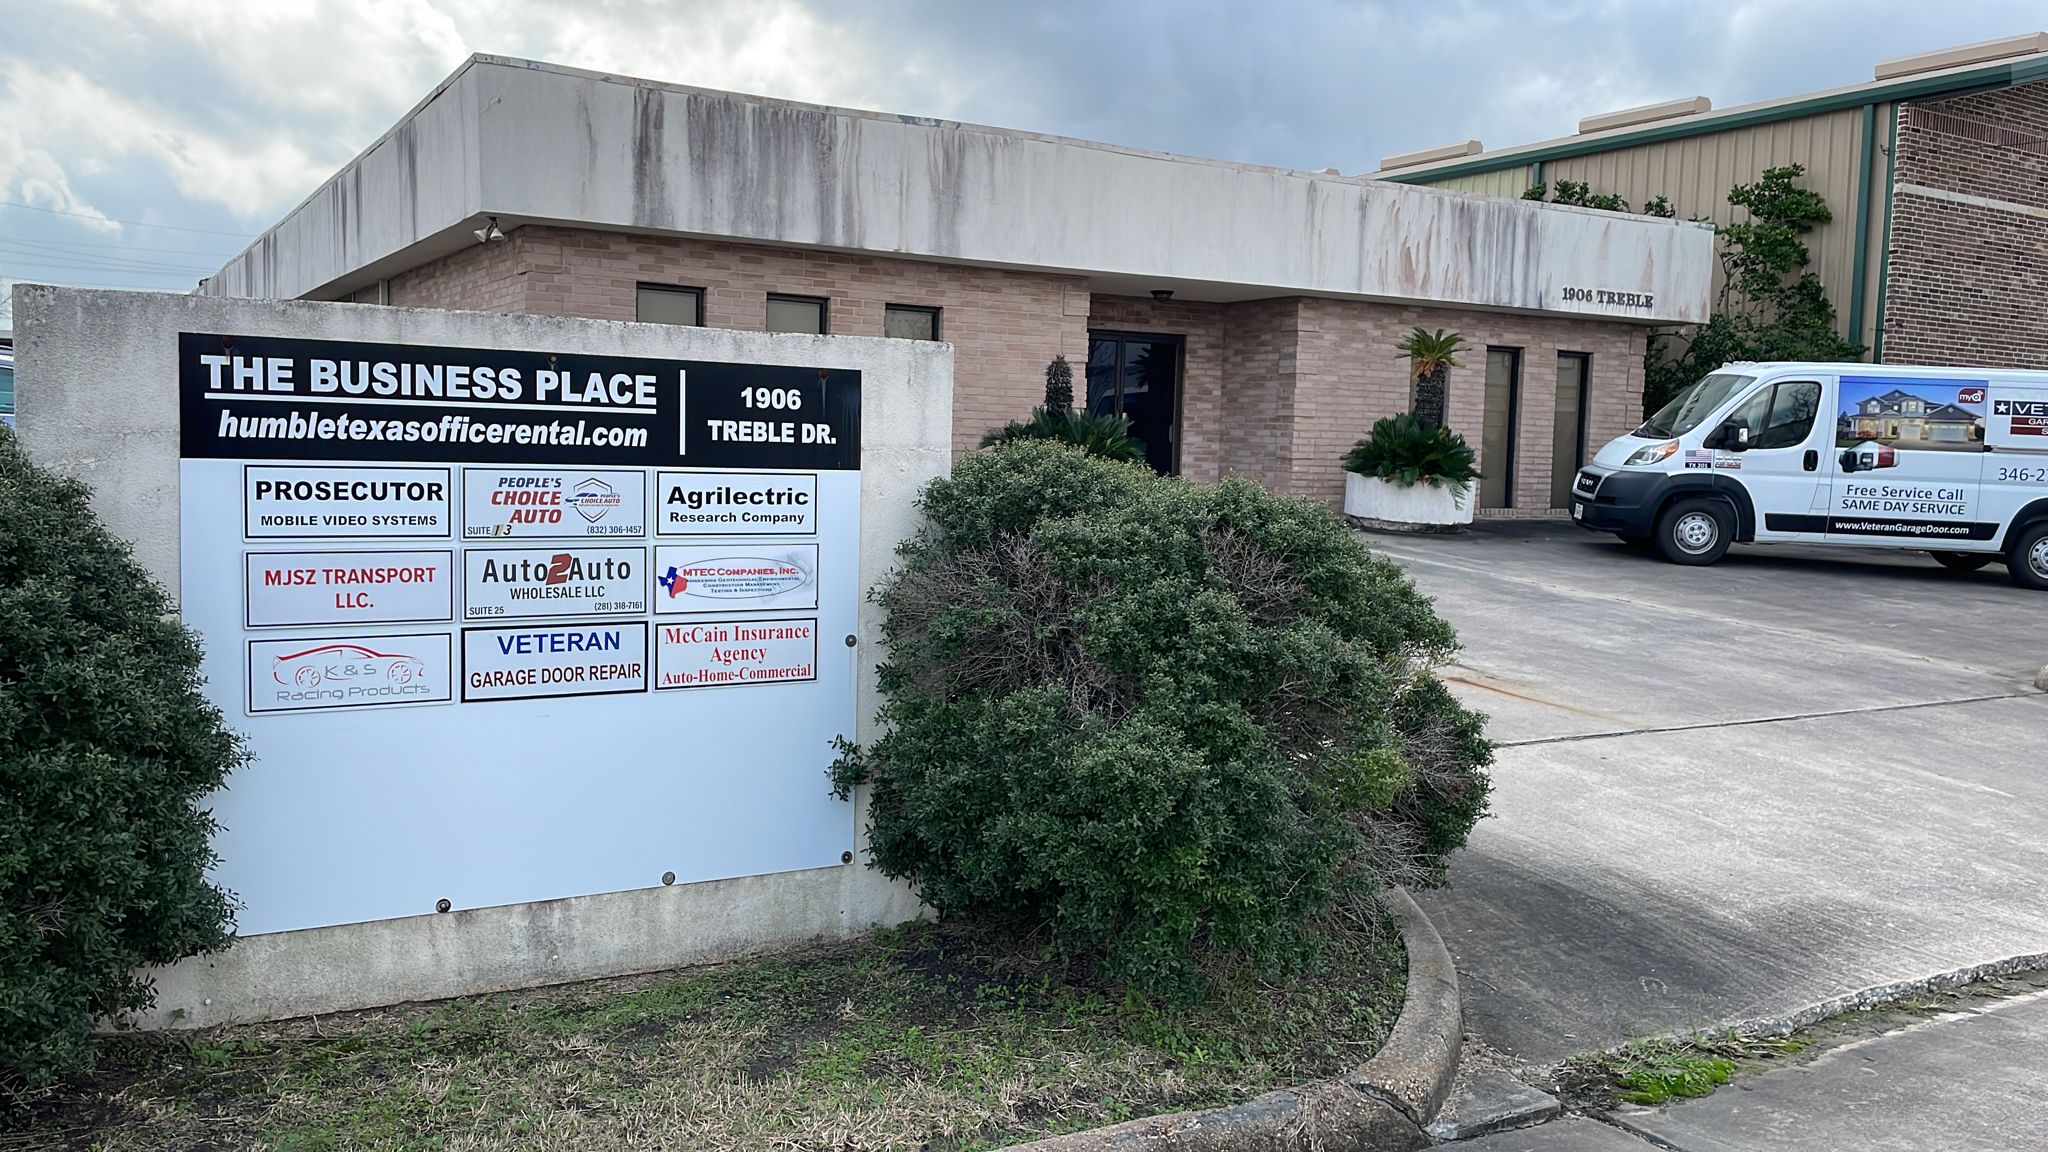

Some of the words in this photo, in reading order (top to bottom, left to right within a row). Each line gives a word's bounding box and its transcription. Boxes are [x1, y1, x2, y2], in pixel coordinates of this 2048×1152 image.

[1562, 287, 1593, 302] 1906
[1596, 290, 1654, 308] TREBLE
[200, 354, 294, 391] THE
[310, 359, 523, 400] BUSINESS
[535, 370, 657, 406] PLACE
[740, 387, 802, 411] 1906
[1960, 392, 1982, 402] myQ
[2015, 403, 2048, 415] VE
[218, 410, 648, 448] humbletexasofficerental.com
[707, 420, 795, 444] TREBLE
[801, 423, 837, 445] DR.
[1998, 467, 2048, 481] 346-2
[498, 477, 562, 488] PEOPLE'S
[255, 480, 444, 502] PROSECUTOR
[491, 491, 562, 506] CHOICE
[667, 486, 809, 510] Agrilectric
[1846, 484, 1877, 496] Free
[1881, 486, 1933, 499] Service
[1937, 488, 1964, 501] Call
[1841, 499, 1880, 511] SAME
[1883, 501, 1909, 512] DAY
[1911, 502, 1965, 515] SERVICE
[261, 515, 318, 526] MOBILE
[322, 515, 368, 526] VIDEO
[372, 515, 438, 526] SYSTEMS
[509, 509, 562, 524] AUTO
[669, 512, 737, 523] Research
[741, 512, 805, 525] Company
[467, 526, 491, 535] SUITE
[586, 525, 607, 535] (832)
[609, 525, 642, 534] 306-1457
[1835, 521, 1970, 535] www.VeteranGarageDoor.com
[264, 569, 317, 586] MJSZ
[322, 567, 437, 585] TRANSPORT
[482, 553, 631, 586] Auto2Auto
[683, 568, 716, 577] MTEC
[335, 592, 374, 609] LLC.
[510, 586, 582, 600] WHOLESALE
[585, 586, 605, 598] LLC
[469, 606, 493, 615] SUITE
[494, 606, 504, 615] 25
[594, 601, 612, 611] (281)
[497, 631, 620, 655] VETERAN
[665, 626, 728, 645] McCain
[734, 625, 810, 641] Insurance
[710, 646, 767, 665] Agency
[325, 666, 338, 677] K
[344, 664, 358, 675] &
[364, 664, 377, 675] S
[470, 669, 537, 688] GARAGE
[541, 666, 585, 684] DOOR
[589, 663, 642, 681] REPAIR
[662, 664, 811, 685] Auto-Home-Commercial
[276, 689, 344, 702] Racing
[349, 683, 431, 697] Products
